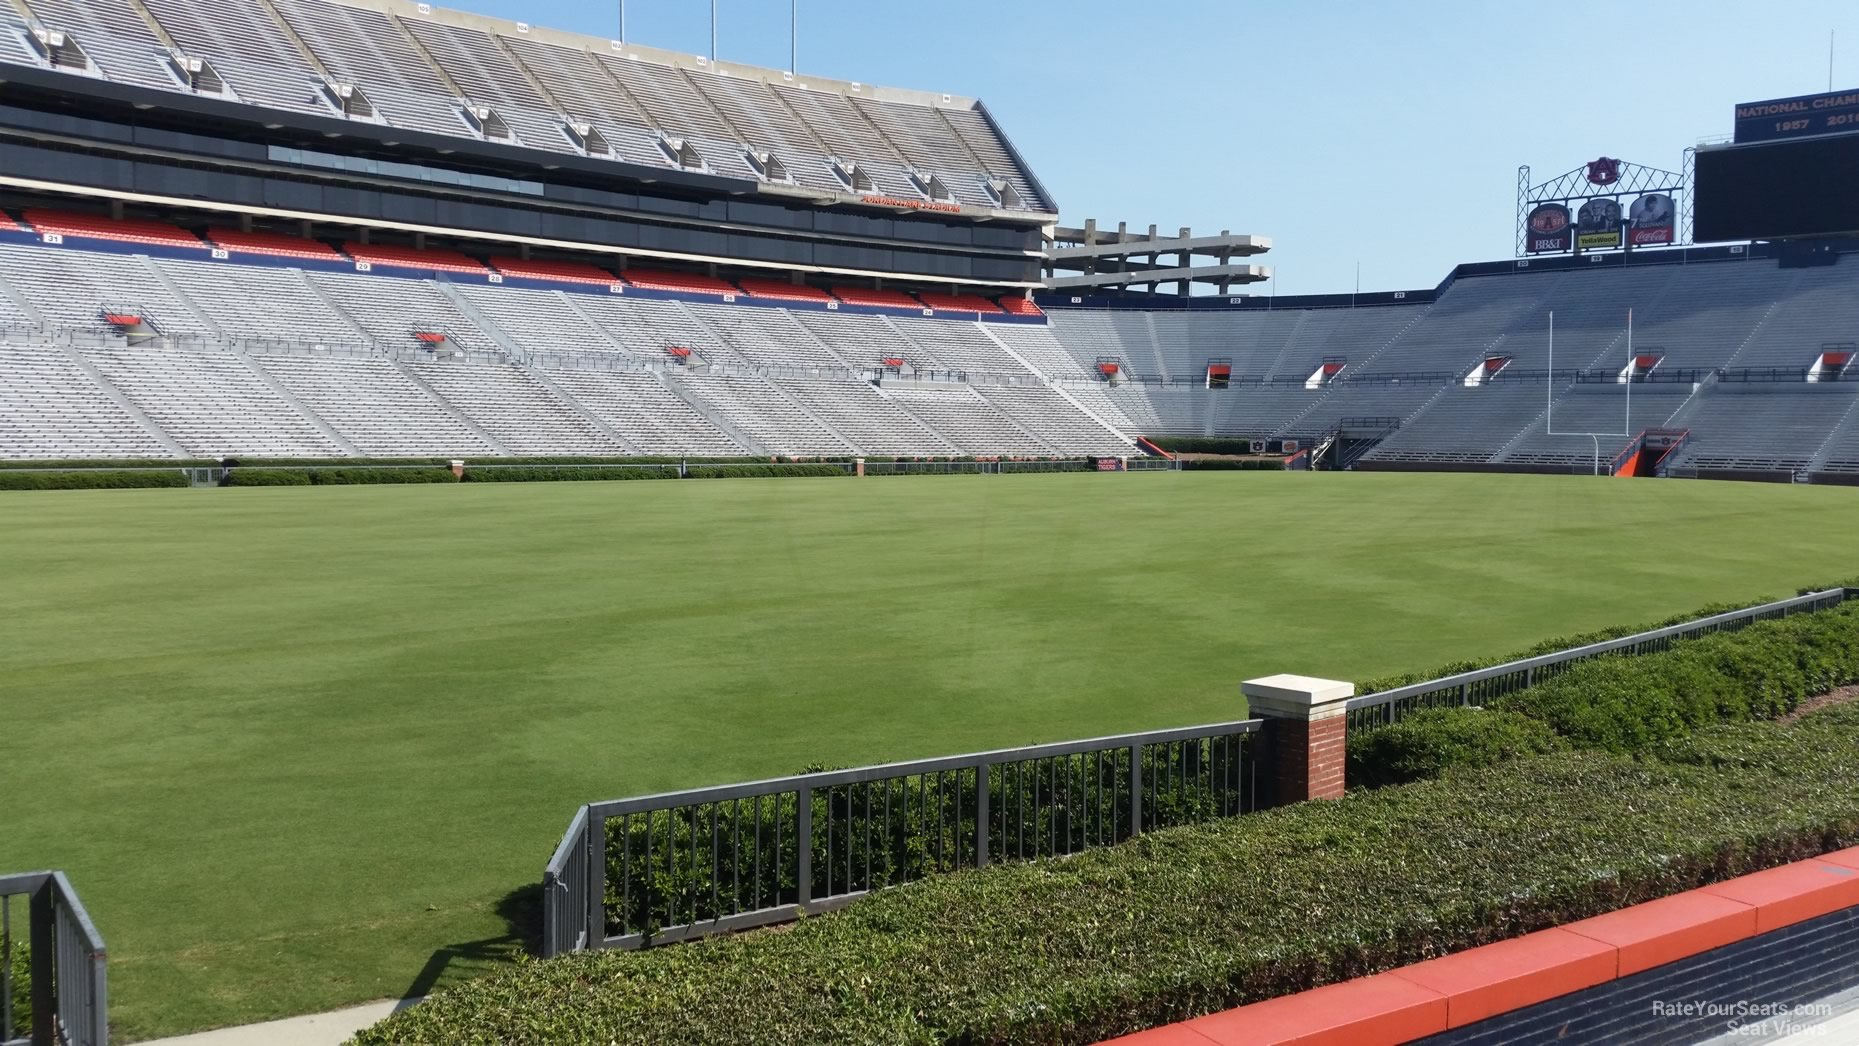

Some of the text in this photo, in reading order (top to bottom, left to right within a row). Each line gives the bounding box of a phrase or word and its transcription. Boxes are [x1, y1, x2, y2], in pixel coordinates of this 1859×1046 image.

[1737, 101, 1808, 118] NATIONAL
[1775, 119, 1809, 132] 1957
[1630, 218, 1638, 229] 7
[48, 235, 59, 243] 31
[1581, 236, 1616, 245] YellaWood
[1535, 238, 1562, 251] BB&T
[214, 249, 226, 258] 30
[358, 261, 369, 270] 29
[491, 275, 500, 283] 28
